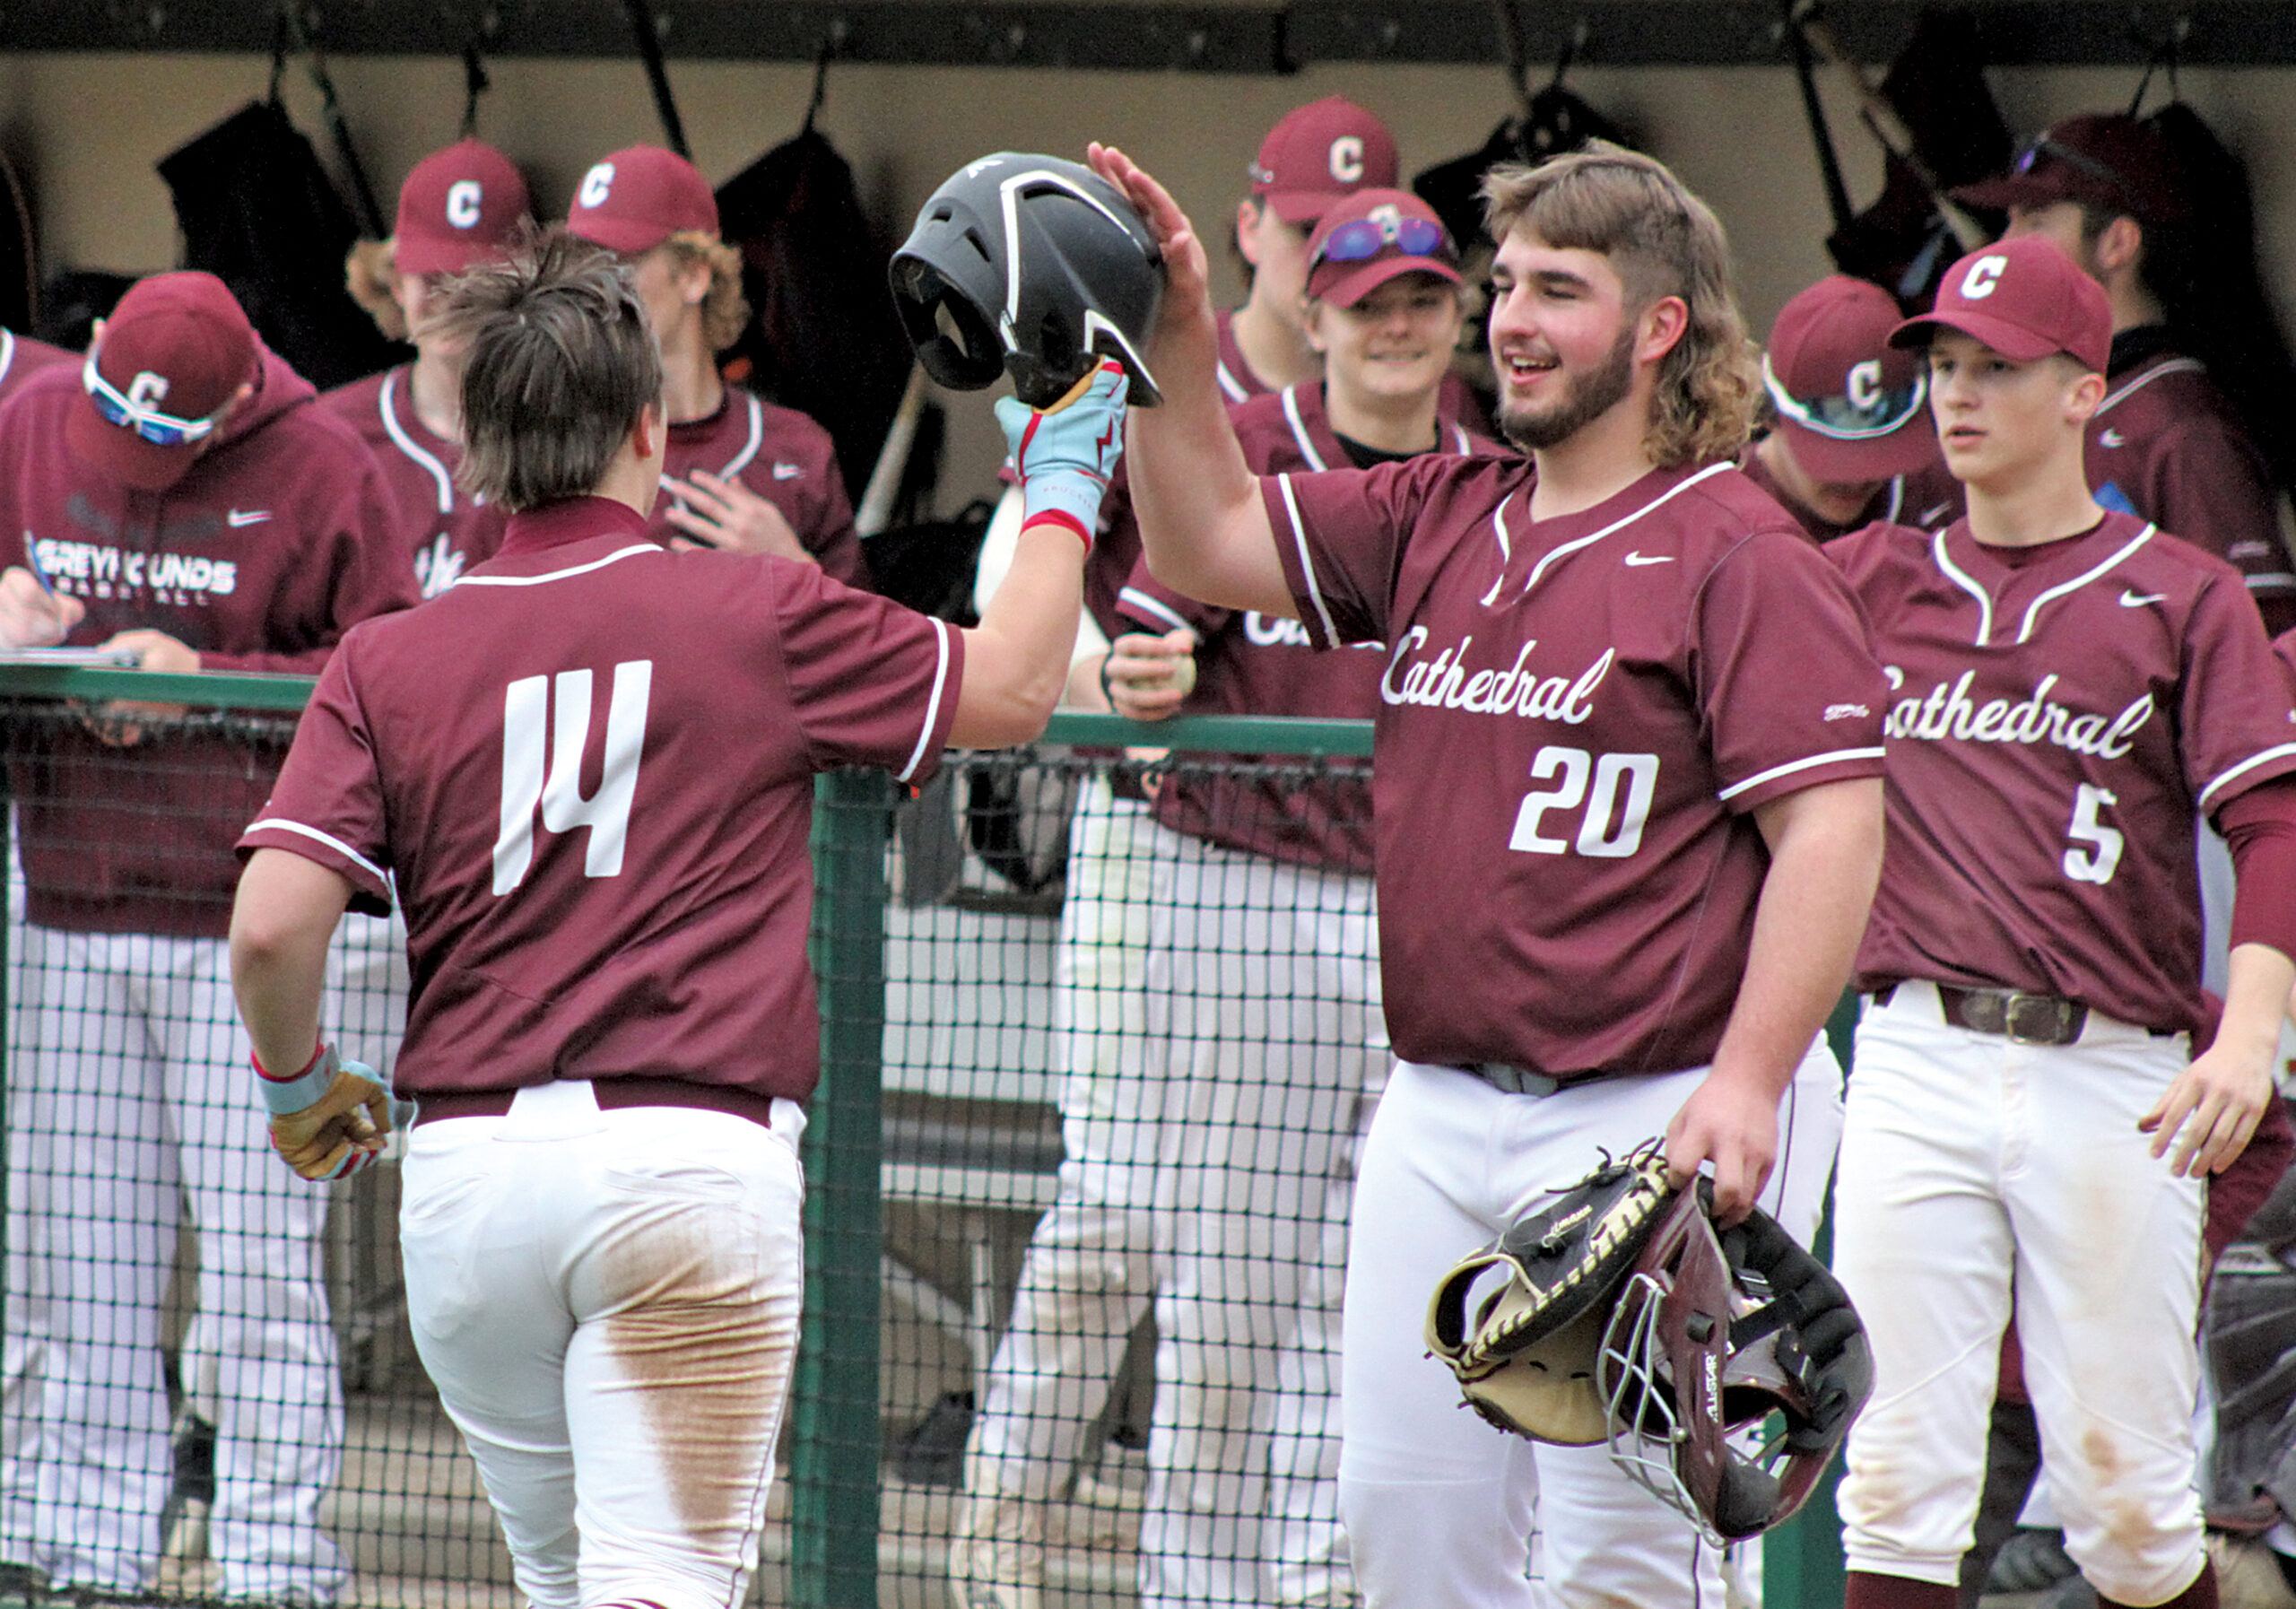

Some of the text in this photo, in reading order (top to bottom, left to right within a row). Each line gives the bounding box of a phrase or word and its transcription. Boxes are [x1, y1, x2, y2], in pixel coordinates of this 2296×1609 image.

[1330, 135, 1363, 183] C
[447, 179, 483, 229] C
[579, 161, 615, 208] C
[1961, 256, 2008, 300] C
[1847, 360, 1882, 408] C
[1381, 625, 1614, 724] Cathedral
[492, 659, 653, 897] 14
[1509, 746, 1659, 857] 20
[2063, 782, 2125, 884] 5
